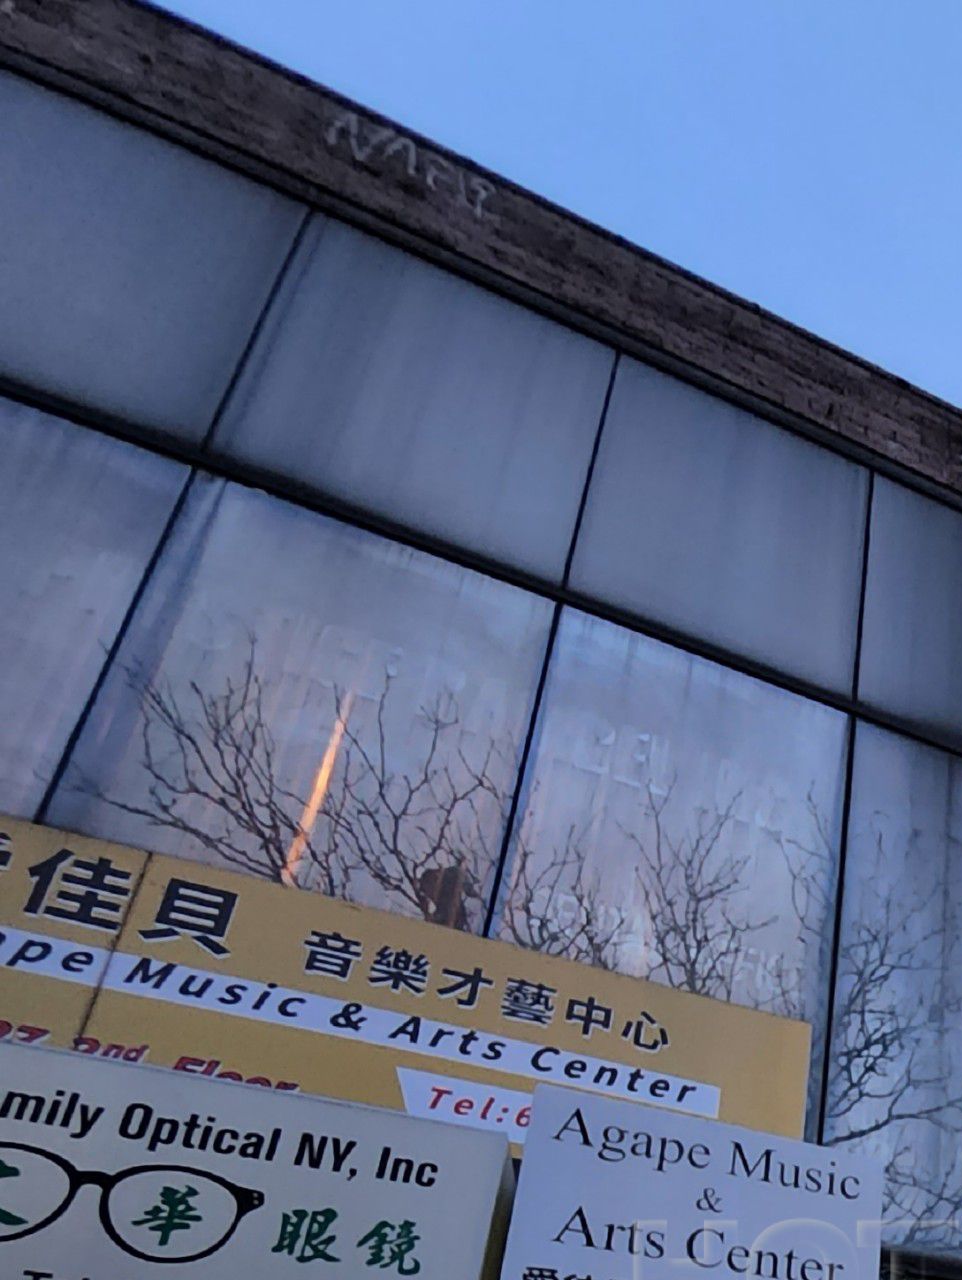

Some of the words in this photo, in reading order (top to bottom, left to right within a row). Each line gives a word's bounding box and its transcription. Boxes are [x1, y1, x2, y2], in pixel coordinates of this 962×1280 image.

[0, 831, 239, 959] 佳貝
[303, 930, 670, 1052] 音樂才藝中心
[0, 930, 94, 973] pe
[123, 957, 306, 1018] Music
[330, 1002, 367, 1031] &
[388, 1015, 506, 1061] Arts
[530, 1047, 697, 1104] Center
[0, 1088, 104, 1139] mily
[118, 1102, 282, 1162] Optical
[294, 1132, 359, 1182] NY,
[375, 1146, 439, 1188] Inc
[552, 1106, 711, 1173] Agape
[727, 1140, 862, 1201] Music
[551, 1205, 665, 1260] Arts
[695, 1186, 723, 1214] &
